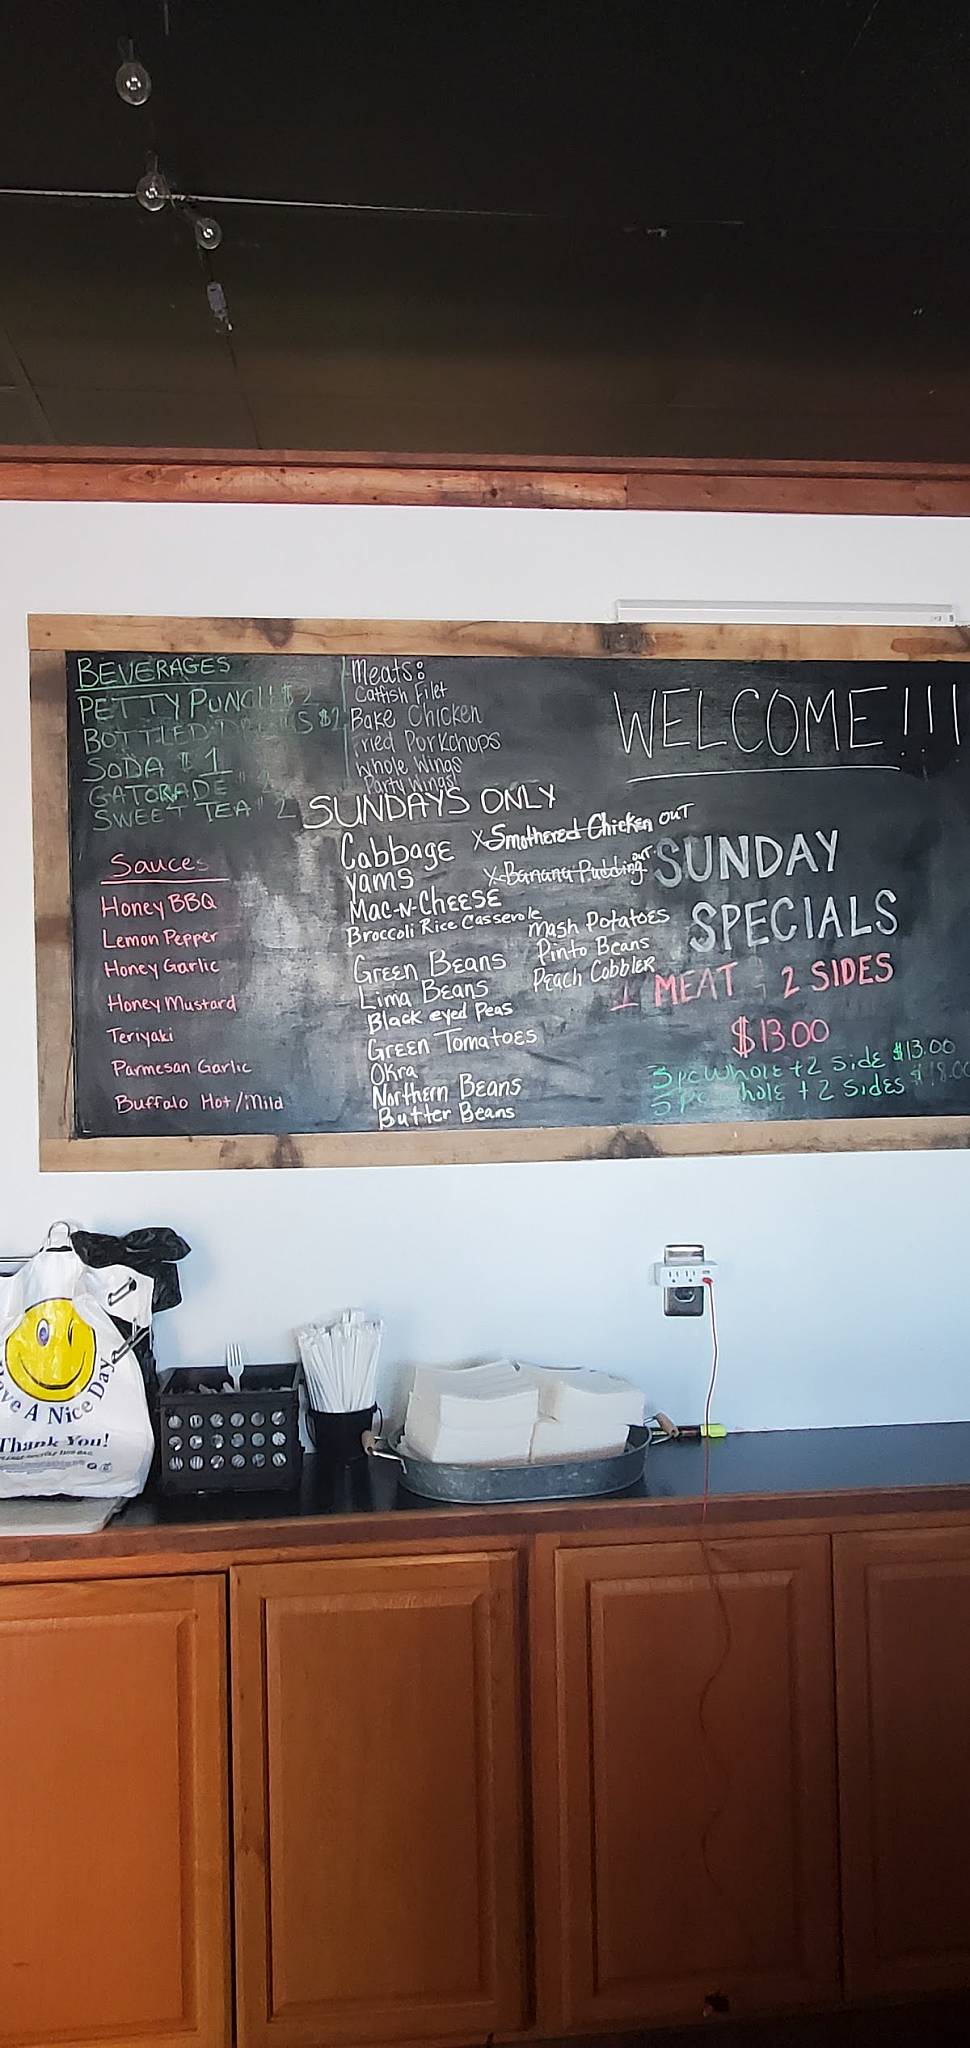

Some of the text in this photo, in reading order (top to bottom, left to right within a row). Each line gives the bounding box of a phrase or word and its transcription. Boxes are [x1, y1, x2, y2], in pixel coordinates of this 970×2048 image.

[77, 656, 231, 689] BEVERAGES
[351, 658, 425, 686] Meats:
[355, 680, 448, 704] Catfish Filet
[78, 692, 180, 724] PETTY
[351, 702, 483, 732] Bake Chicken
[83, 721, 209, 755] BOTTLED
[82, 757, 164, 782] SODA
[356, 754, 463, 780] Whole Wings
[89, 776, 229, 808] GATORADE
[363, 775, 406, 795] Party
[93, 804, 188, 831] SWEET
[195, 799, 252, 823] TEA
[303, 787, 470, 830] SUNDAYS
[480, 784, 556, 815] ONLY
[587, 811, 654, 840] Chicken
[110, 853, 209, 878] Sauces
[341, 831, 455, 871] Cabbage
[654, 829, 839, 888] SUNDAY
[503, 861, 575, 886] Banana
[101, 893, 218, 920] Honey BBQ
[586, 908, 670, 932] Potatoes
[689, 889, 898, 951] SPECIALS
[102, 928, 219, 949] Lemon Pepper
[346, 906, 543, 948] Broccoli Rice Casserole
[537, 936, 650, 966] Pinto Beans
[104, 958, 220, 980] Honey Garlic
[353, 949, 507, 984] Green Beans
[655, 962, 738, 1007] MEAT
[781, 965, 801, 999] 2
[810, 952, 895, 993] SIDES
[107, 993, 237, 1013] Honey Mustard
[359, 978, 488, 1010] Lima Beans
[367, 1001, 513, 1035] Black eyed Peas
[106, 1027, 174, 1048] Teriyaki
[367, 1027, 538, 1061] Green Tomatoes
[111, 1059, 253, 1077] Parmesan Garlic
[115, 1094, 189, 1114] Buffalo
[372, 1073, 522, 1110] Northern Beans
[378, 1101, 516, 1131] Butter Beans
[24, 1403, 39, 1422] A
[48, 1400, 94, 1425] Nice
[87, 1358, 115, 1401] Day
[0, 1433, 109, 1453] Thank You!
